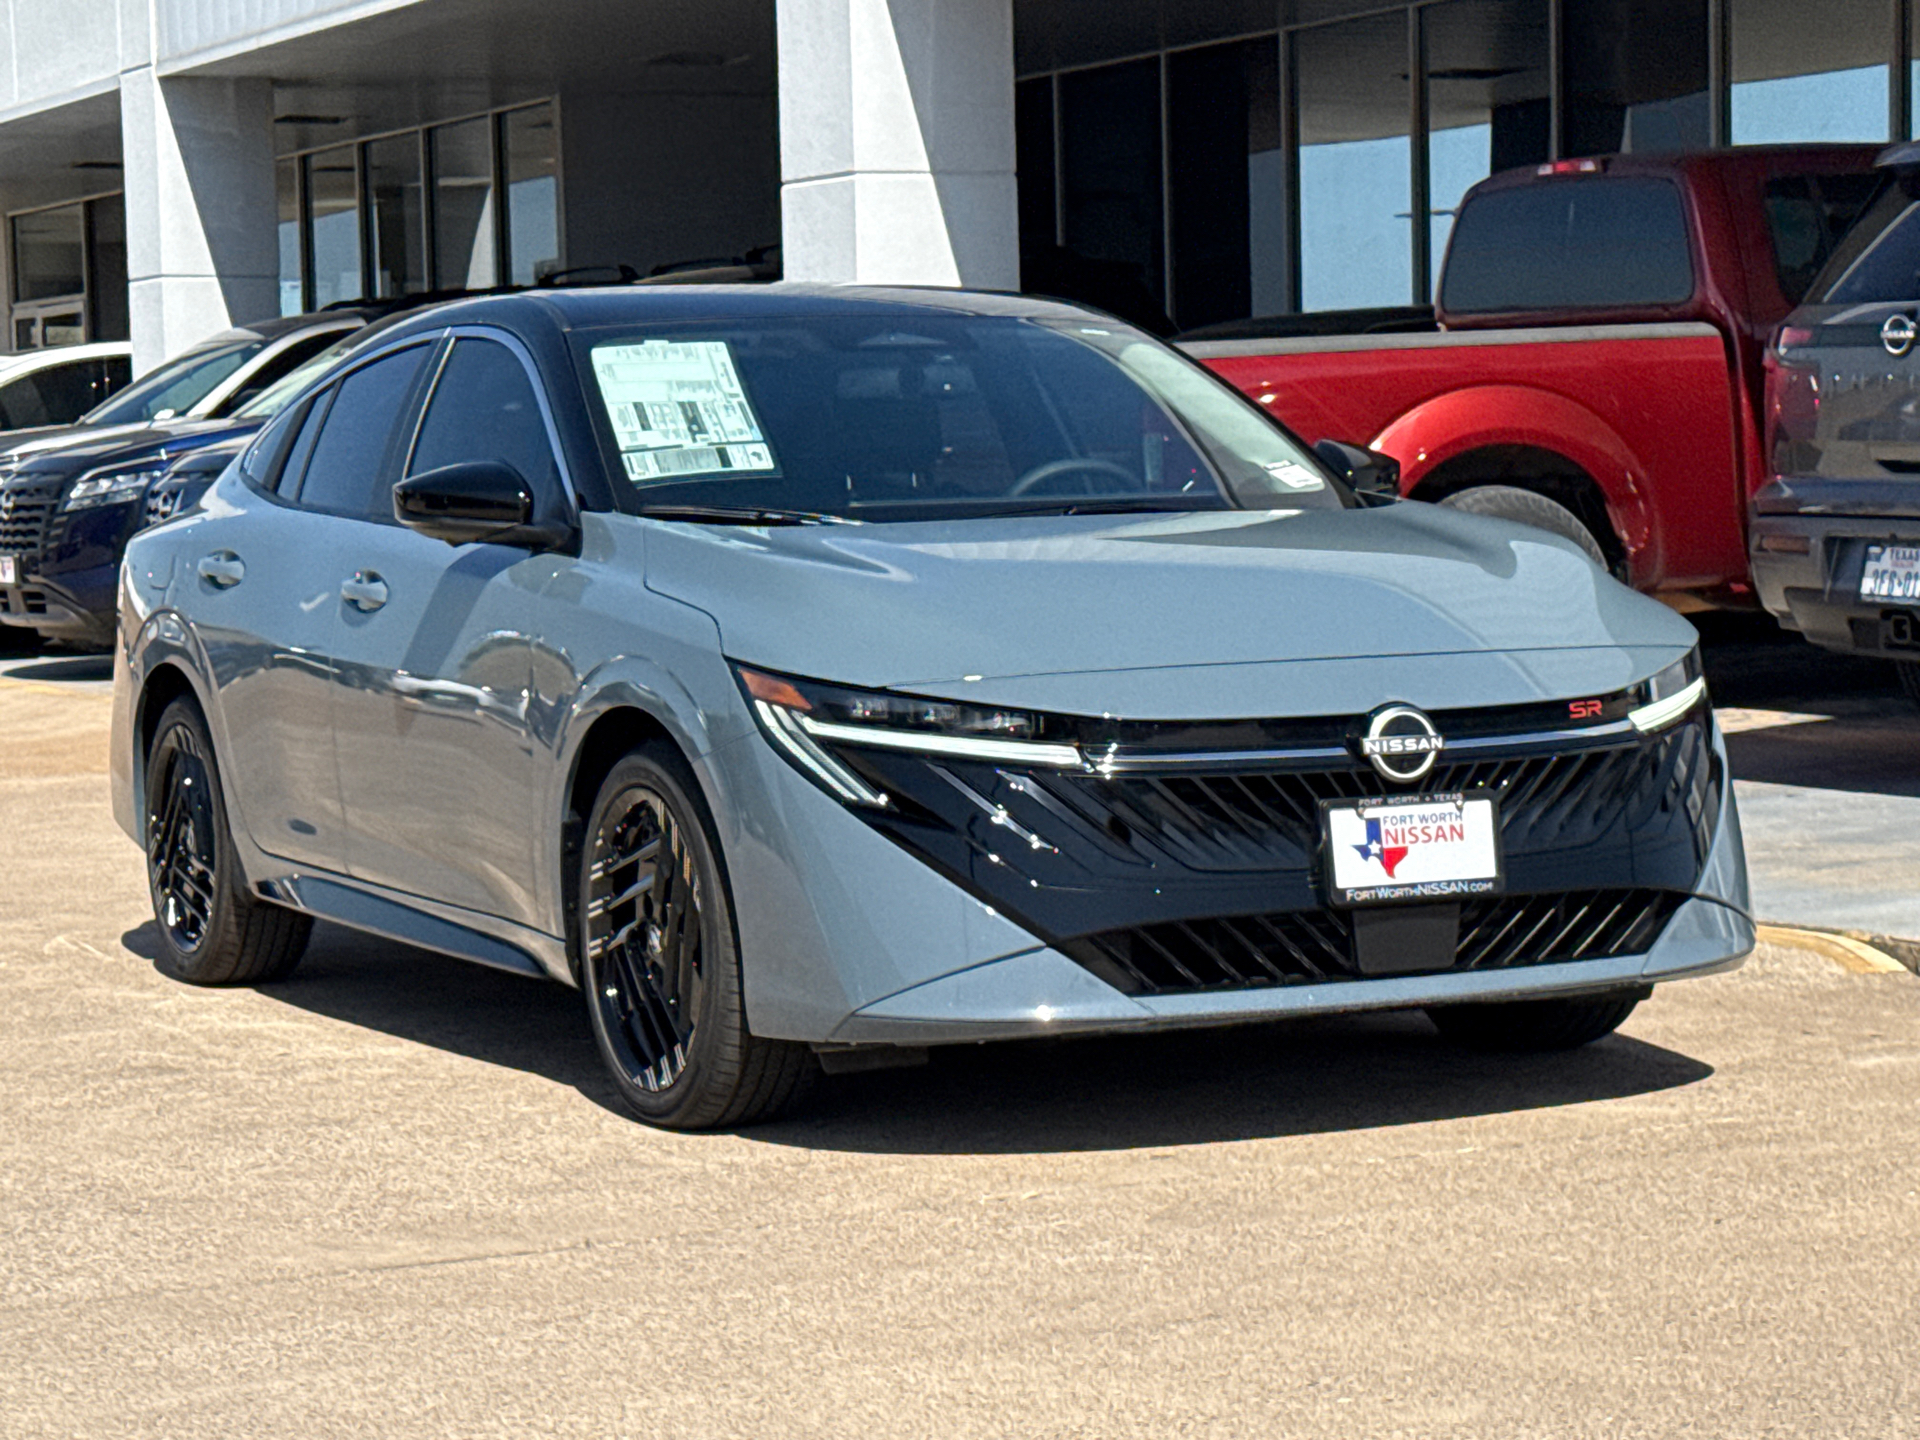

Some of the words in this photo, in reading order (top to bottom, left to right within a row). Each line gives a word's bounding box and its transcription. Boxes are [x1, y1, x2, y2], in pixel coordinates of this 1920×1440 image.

[1889, 547, 1920, 561] TEXAS
[1568, 699, 1603, 719] SR
[1364, 735, 1444, 754] NISSAN
[1358, 798, 1384, 807] FORT
[1387, 795, 1420, 805] WORTH
[1434, 792, 1464, 802] TEXAS
[1383, 814, 1415, 826] FORT
[1418, 811, 1463, 824] WORTH
[1384, 823, 1465, 846] NISSAN
